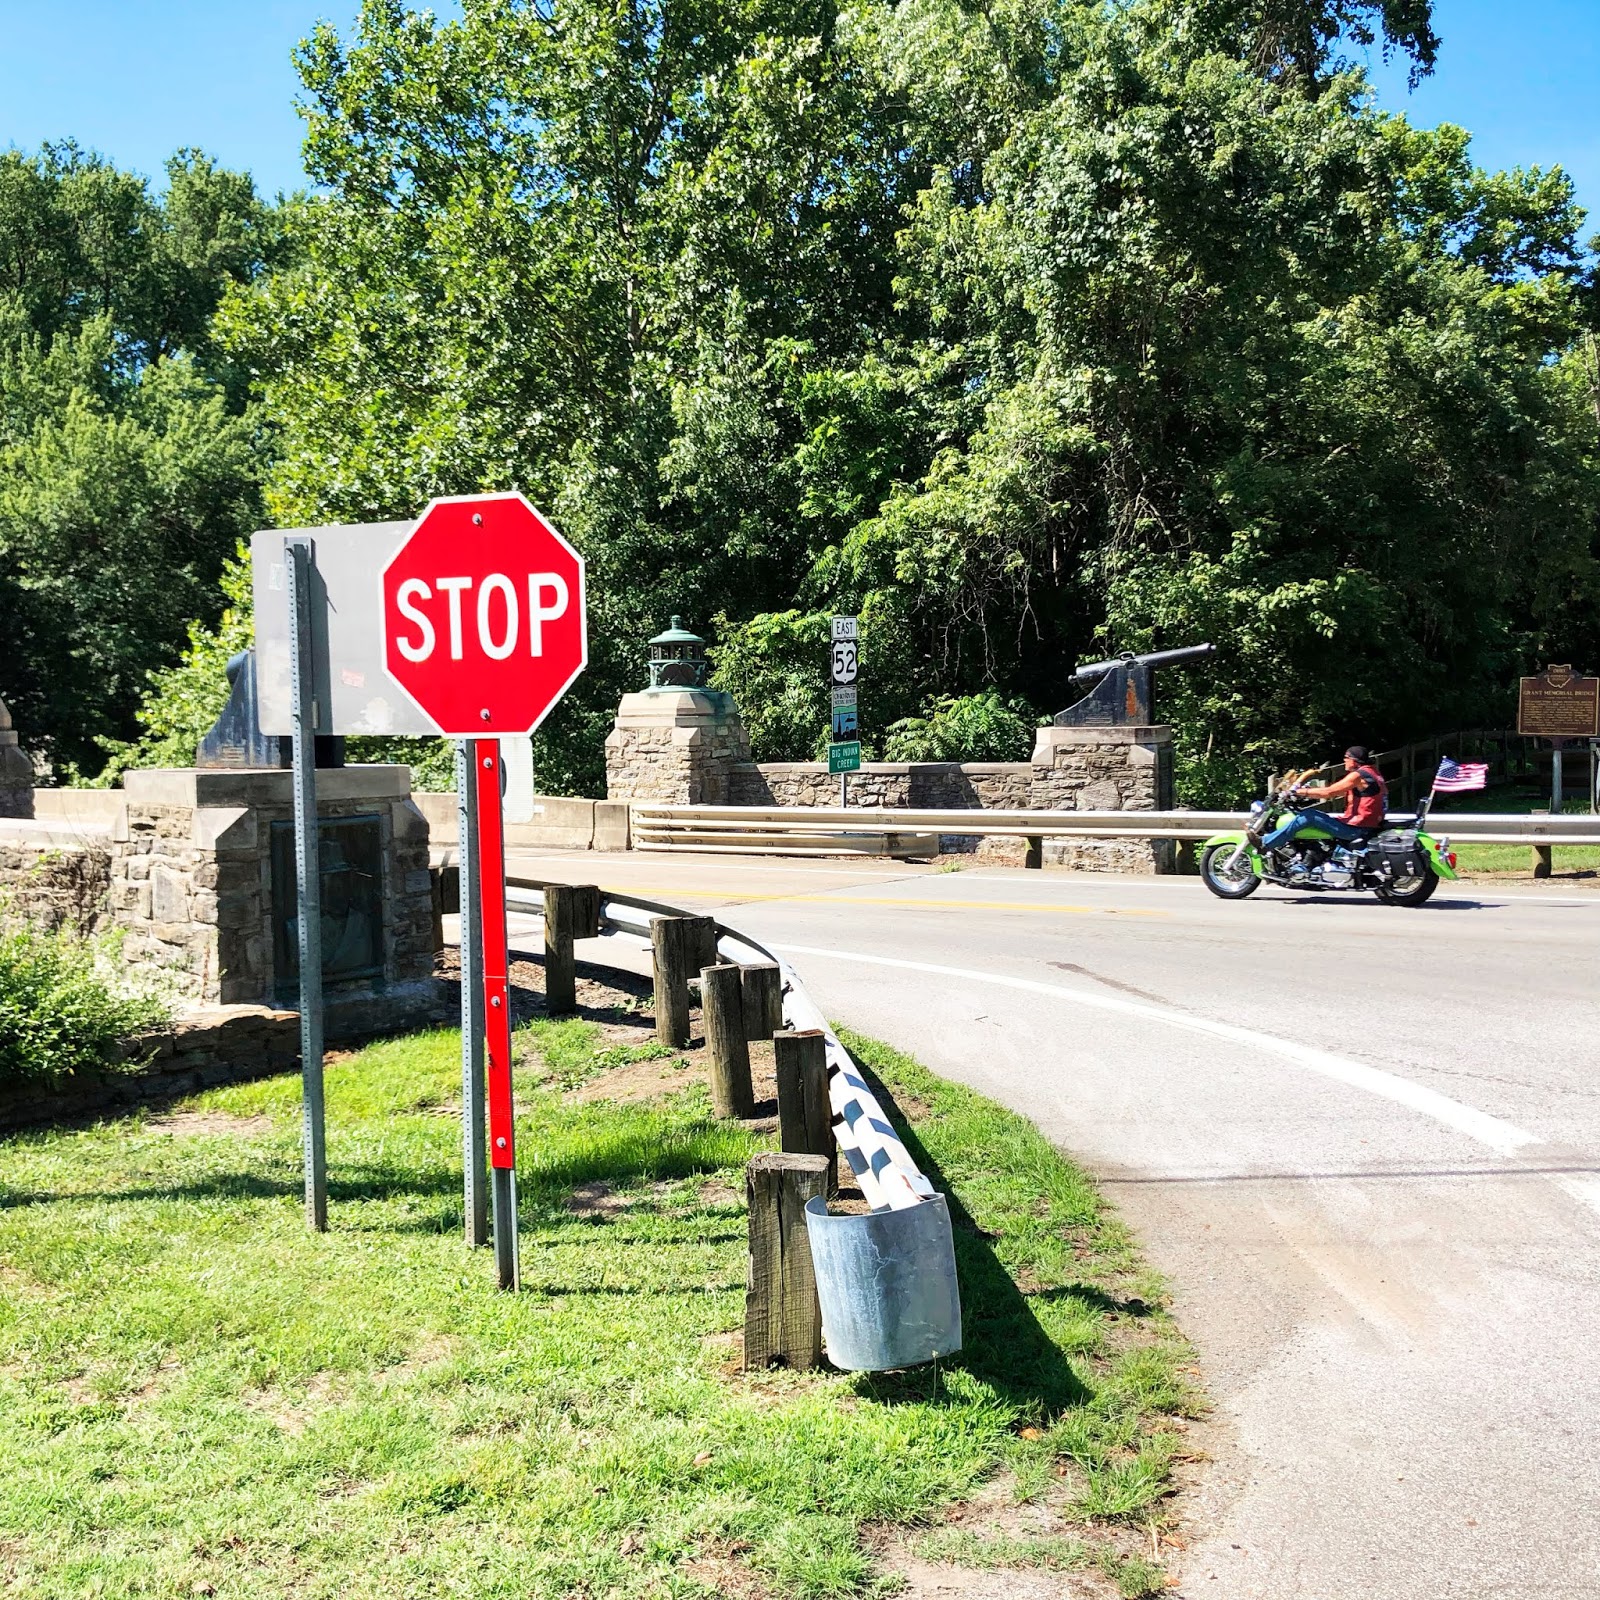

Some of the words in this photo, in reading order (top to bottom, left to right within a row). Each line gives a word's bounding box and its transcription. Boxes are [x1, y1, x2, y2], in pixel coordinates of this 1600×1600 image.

[396, 572, 569, 662] STOP
[836, 621, 853, 635] EAST
[835, 649, 855, 675] 52
[831, 748, 841, 758] BIG
[842, 746, 858, 757] INDIAN
[836, 758, 853, 769] CREEK
